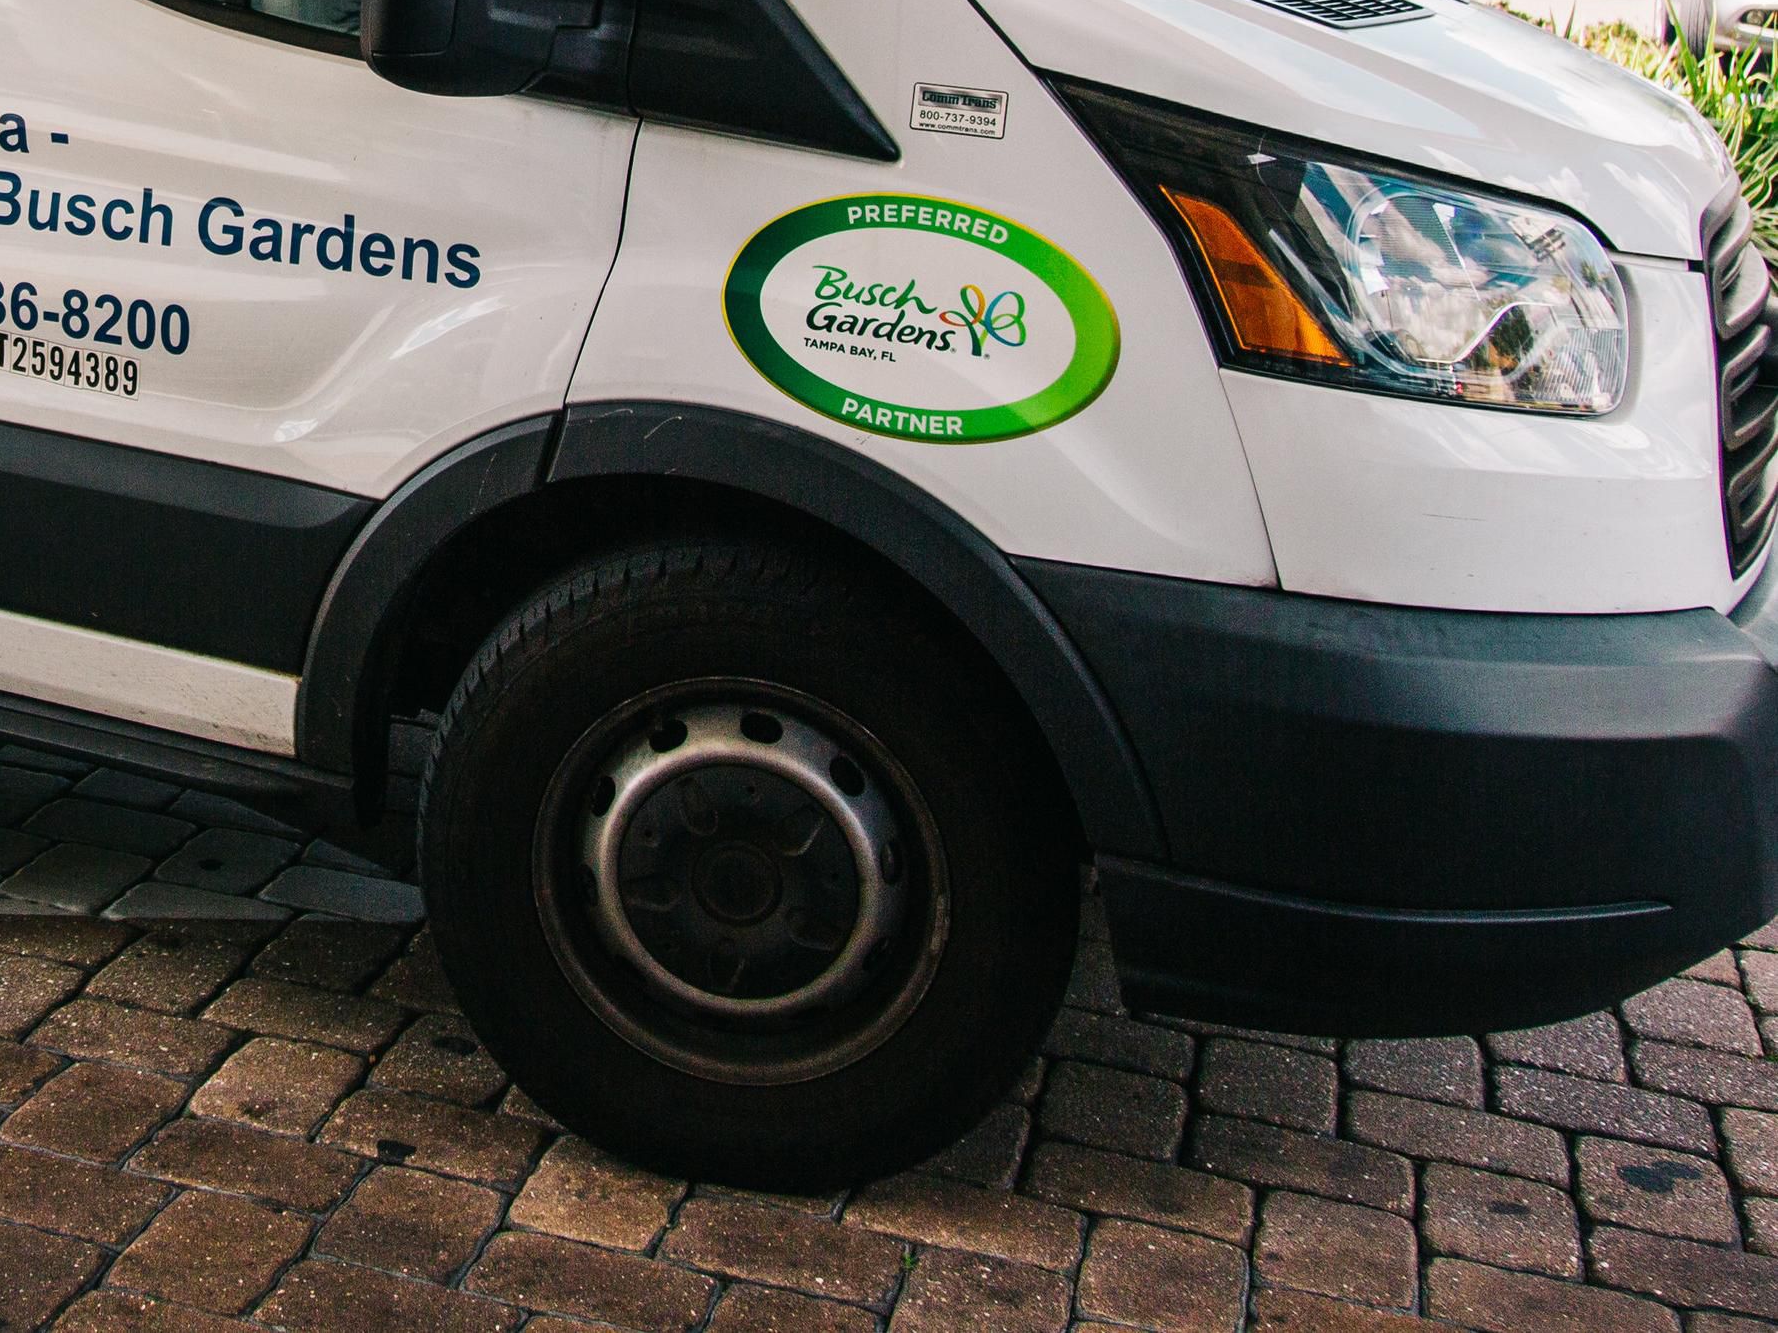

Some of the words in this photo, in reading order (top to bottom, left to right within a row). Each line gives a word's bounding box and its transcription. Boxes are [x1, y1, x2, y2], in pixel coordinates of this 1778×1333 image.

[919, 110, 997, 126] 800-737-9394
[922, 90, 960, 106] Comm
[961, 95, 999, 109] Trans
[919, 121, 996, 135] www.commtrans.com
[197, 196, 482, 289] Gardens
[847, 203, 1009, 245] PREFERRED
[812, 264, 938, 314] Busch
[805, 301, 957, 352] Gardens
[803, 337, 846, 354] TAMPA
[849, 345, 878, 361] BAY,
[880, 351, 897, 363] FL
[840, 396, 965, 435] PARTNER
